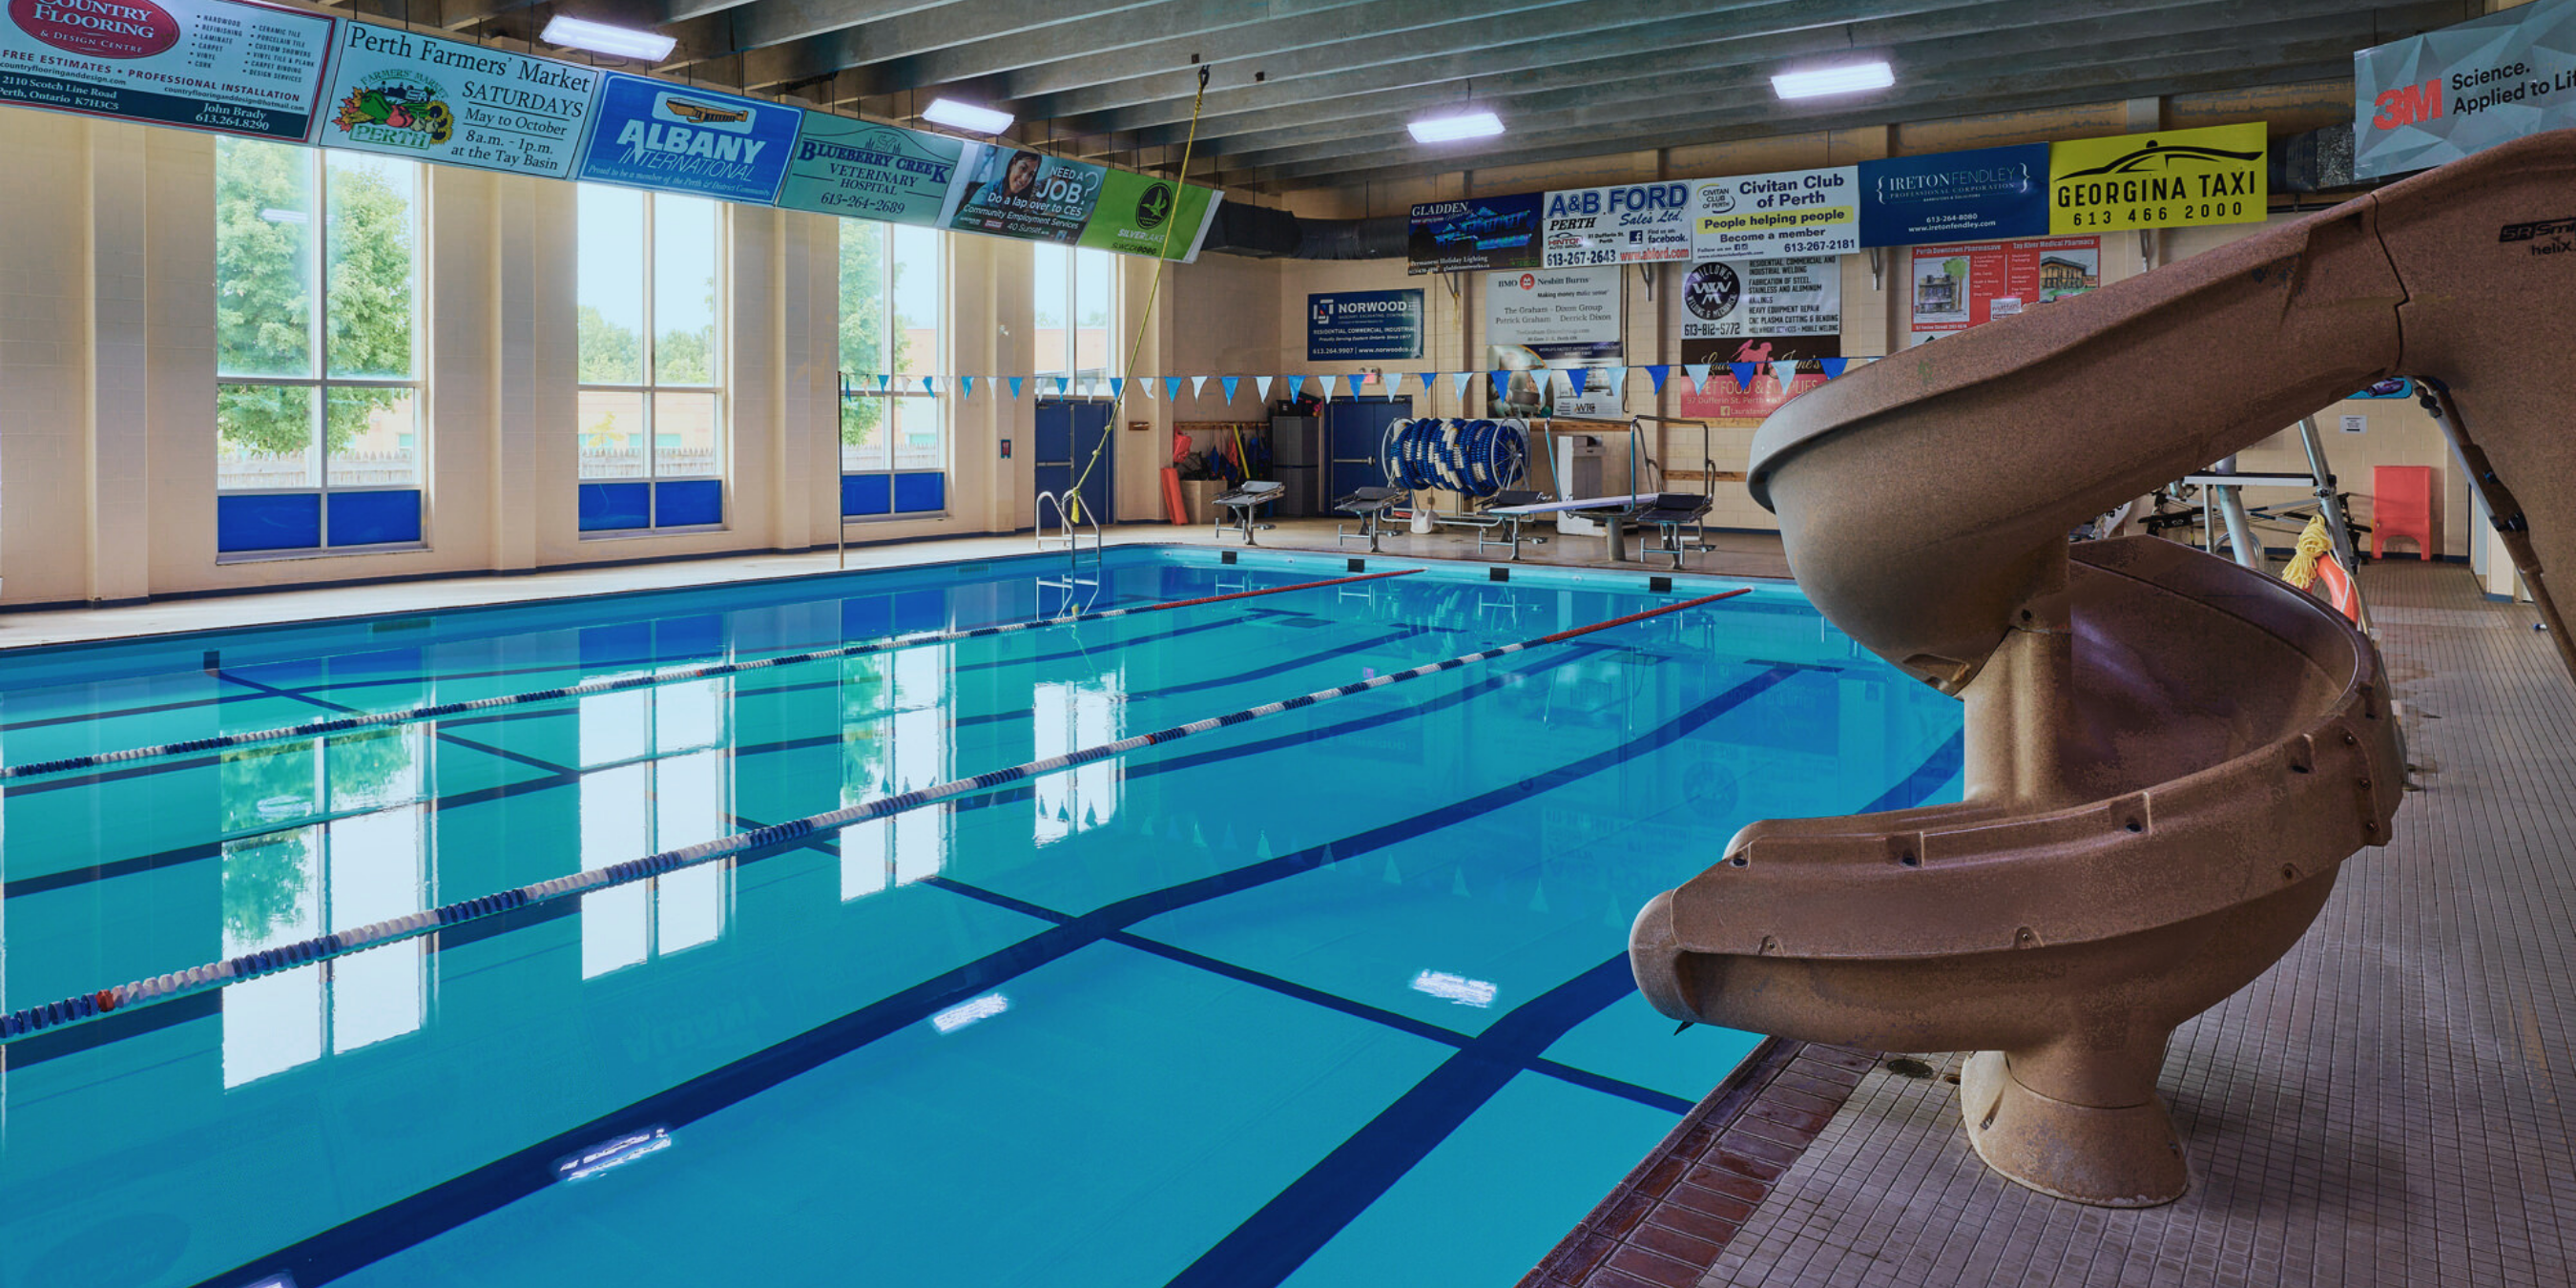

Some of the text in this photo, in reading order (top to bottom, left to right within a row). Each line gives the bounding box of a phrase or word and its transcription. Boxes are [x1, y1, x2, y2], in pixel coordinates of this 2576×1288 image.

[32, 3, 155, 38] FLOORING
[203, 14, 241, 27] HARDWOOD
[199, 33, 233, 45] LAMINATE
[201, 24, 242, 37] REFINISHING
[259, 25, 301, 38] CERAMIC TILE
[53, 31, 96, 46] DESIGN
[100, 39, 143, 52] CENTRE
[197, 43, 224, 52] CARPET
[257, 34, 290, 46] PORCELAIN
[197, 52, 216, 60] VINYL
[253, 52, 287, 63] VINYL TILE
[255, 43, 311, 58] CUSTOM SHOWERS
[348, 25, 412, 58] Perth
[516, 60, 591, 93] Market
[2, 49, 301, 102] FREE ESTIMATES PROFESSIONAL INSTALLATION
[251, 60, 302, 74] CARPET BINDING
[249, 69, 302, 83] DESIGN SERVICES
[2452, 61, 2531, 91] Science.
[2, 75, 117, 99] 2110 Scotch Line Road
[30, 91, 119, 111] Ontario K7H3C5
[164, 86, 305, 112] countryflooringanddesign@hotmail.com
[462, 80, 583, 118] SATURDAYS
[2373, 77, 2443, 131] 3M
[2453, 82, 2525, 115] Applied
[2530, 81, 2550, 96] to
[202, 102, 267, 120] John Brady
[195, 114, 270, 131] 613.264.8290
[465, 107, 568, 135] May to October
[352, 125, 427, 147] PERTH
[466, 129, 553, 155] 8a.m. 1p.m.
[615, 118, 768, 164] ALBANY
[450, 145, 558, 170] at the Tay Basin
[617, 147, 758, 182] INTERNATIONAL
[798, 140, 951, 184] BLUEBERRY CREEK
[588, 164, 736, 192] Proud member the Perth District
[829, 162, 920, 188] VETERINARY
[1050, 165, 1084, 181] NEED A
[840, 177, 899, 196] HOSPITAL
[1702, 187, 1730, 197] CIVITAN
[1739, 173, 1845, 195] Civitan Club
[1890, 182, 2016, 199] PROFESSIONAL CORPORATION
[2057, 170, 2255, 209] GEORGINA TAXI
[821, 192, 905, 215] 613-264-2689
[987, 192, 1083, 218] Do lap over to CES
[1547, 182, 1690, 219] A&B FORD
[1756, 190, 1825, 209] of Perth
[963, 203, 1007, 219] Community
[1007, 211, 1050, 225] Employment
[1050, 218, 1079, 230] Services
[1411, 201, 1469, 218] GLADDEN
[1618, 209, 1683, 227] Sales Ltd.
[2073, 200, 2243, 227] 613 466 2000
[1548, 217, 1598, 232] PERTH
[1704, 208, 1845, 230] People helping people
[1908, 219, 1996, 233] www.iretonfendley.com
[1925, 213, 1978, 224] 613-264-8080
[1018, 223, 1042, 233] Sunset
[1117, 228, 1165, 243] SILVERLAKE
[1720, 233, 1765, 243] Become
[1777, 227, 1826, 239] member
[1783, 239, 1855, 253] 613-267-2181
[1916, 243, 2003, 256] Perth Downtown Pharmasave
[2039, 239, 2064, 248] Medical
[2064, 239, 2095, 247] Pharmacy
[1439, 255, 1488, 266] Holiday Lighting
[1546, 249, 1616, 267] 613-267-2643
[1619, 247, 1690, 262] www.abford.com
[1692, 264, 1733, 281] WILLOWS
[1749, 265, 1807, 276] INDUSTRIAL WELDING
[1498, 276, 1589, 288] BMO Nesbitt Burns
[1748, 285, 1777, 294] STAINLESS
[1791, 283, 1822, 292] ALUMINUM
[1749, 278, 1783, 286] FABRICATION
[1338, 301, 1407, 314] NORWOOD
[1504, 303, 1604, 315] The Graham Dixon Group
[1749, 304, 1819, 315] HEAVY EQUIPMENT REPAIR
[1495, 313, 1611, 325] Patrick Graham Derrick Dixon
[1760, 314, 1839, 324] PLASMA CUTTING BENDING
[1684, 322, 1741, 336] 613-812-5772
[1755, 381, 1764, 395] &
[1687, 396, 1696, 405] 97
[1698, 396, 1729, 405] Dufferin
[1742, 396, 1764, 405] Perth
